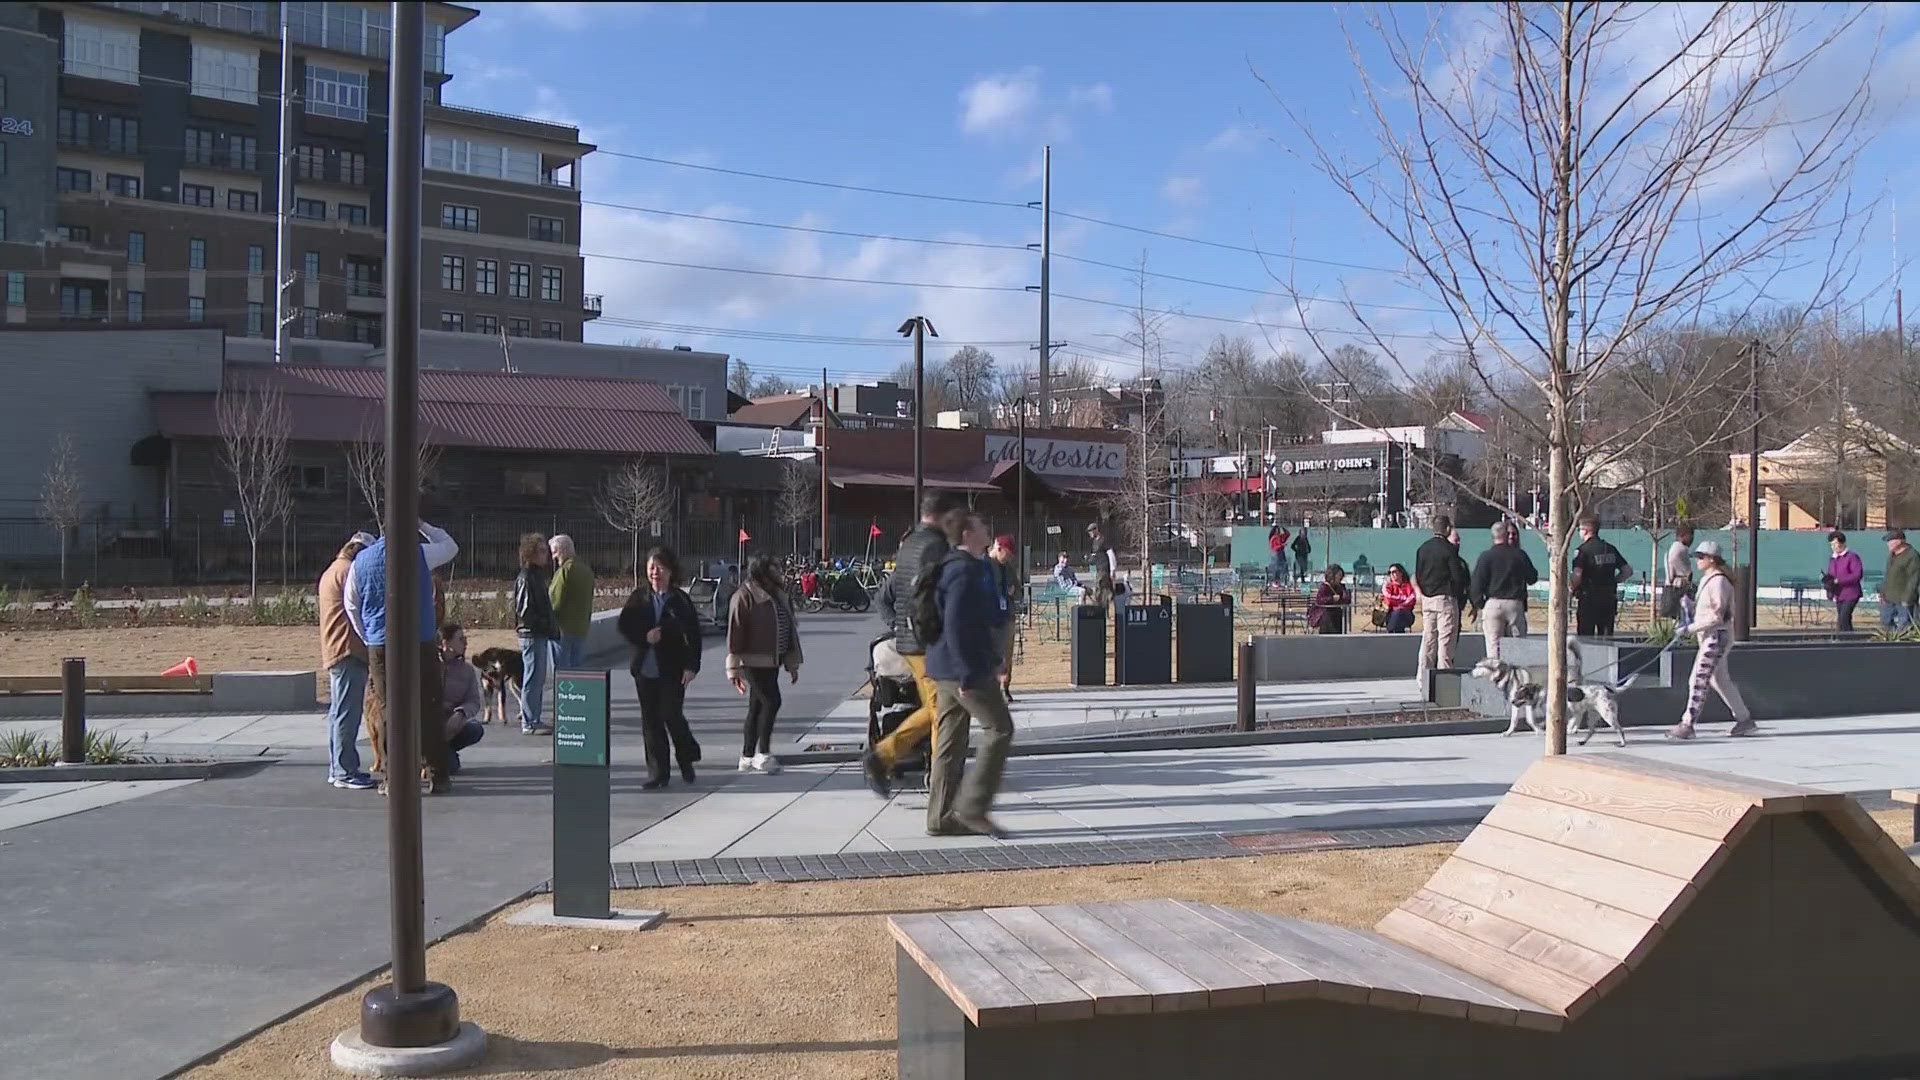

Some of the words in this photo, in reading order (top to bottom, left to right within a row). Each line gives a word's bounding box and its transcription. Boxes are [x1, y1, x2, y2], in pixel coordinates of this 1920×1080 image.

[985, 441, 1119, 471] Majestic
[1295, 460, 1332, 473] JIMMY
[1334, 457, 1373, 471] JOHN'S
[568, 693, 586, 701] Spring
[558, 732, 586, 740] Razorback
[558, 740, 584, 748] Greenway
